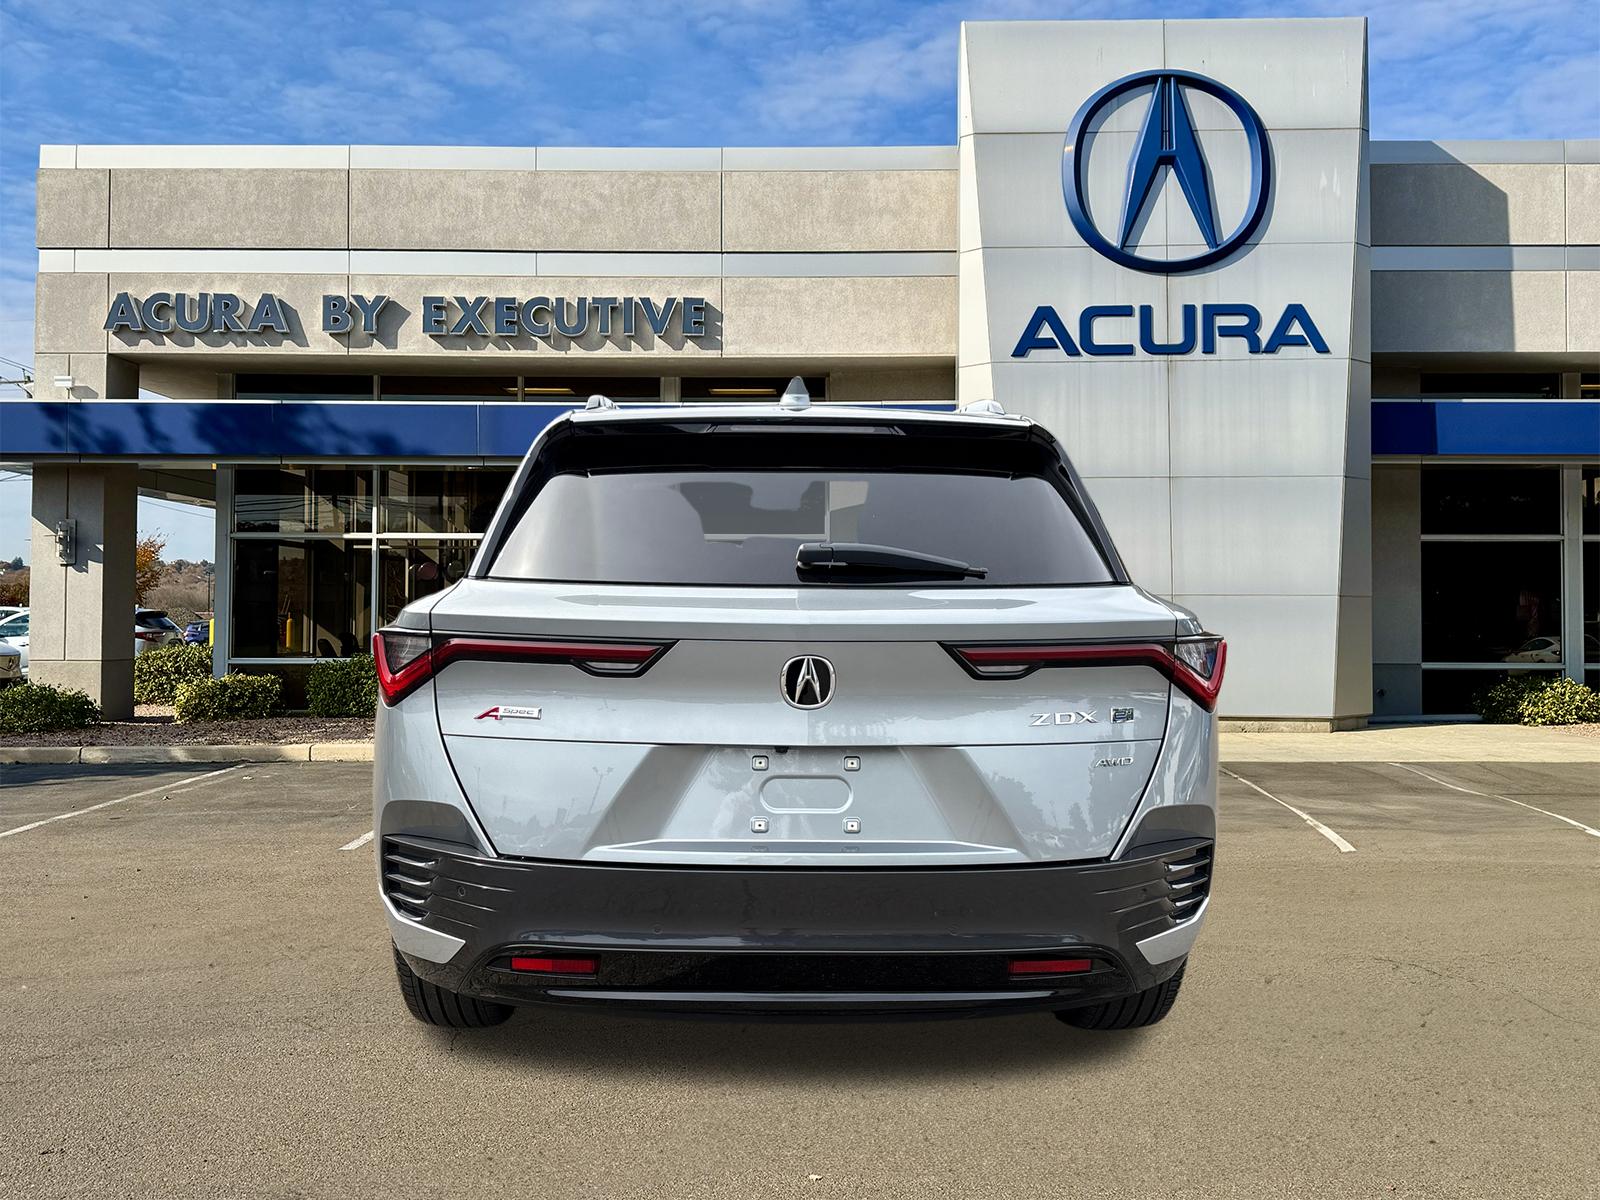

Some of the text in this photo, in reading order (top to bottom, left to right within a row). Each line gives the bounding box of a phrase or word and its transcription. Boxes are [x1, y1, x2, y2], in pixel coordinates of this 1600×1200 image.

[104, 291, 706, 336] ACURA BY EXECUTIVE
[1011, 303, 1332, 357] ACURA
[1029, 711, 1098, 726] ZDX
[1095, 757, 1135, 768] AWD
